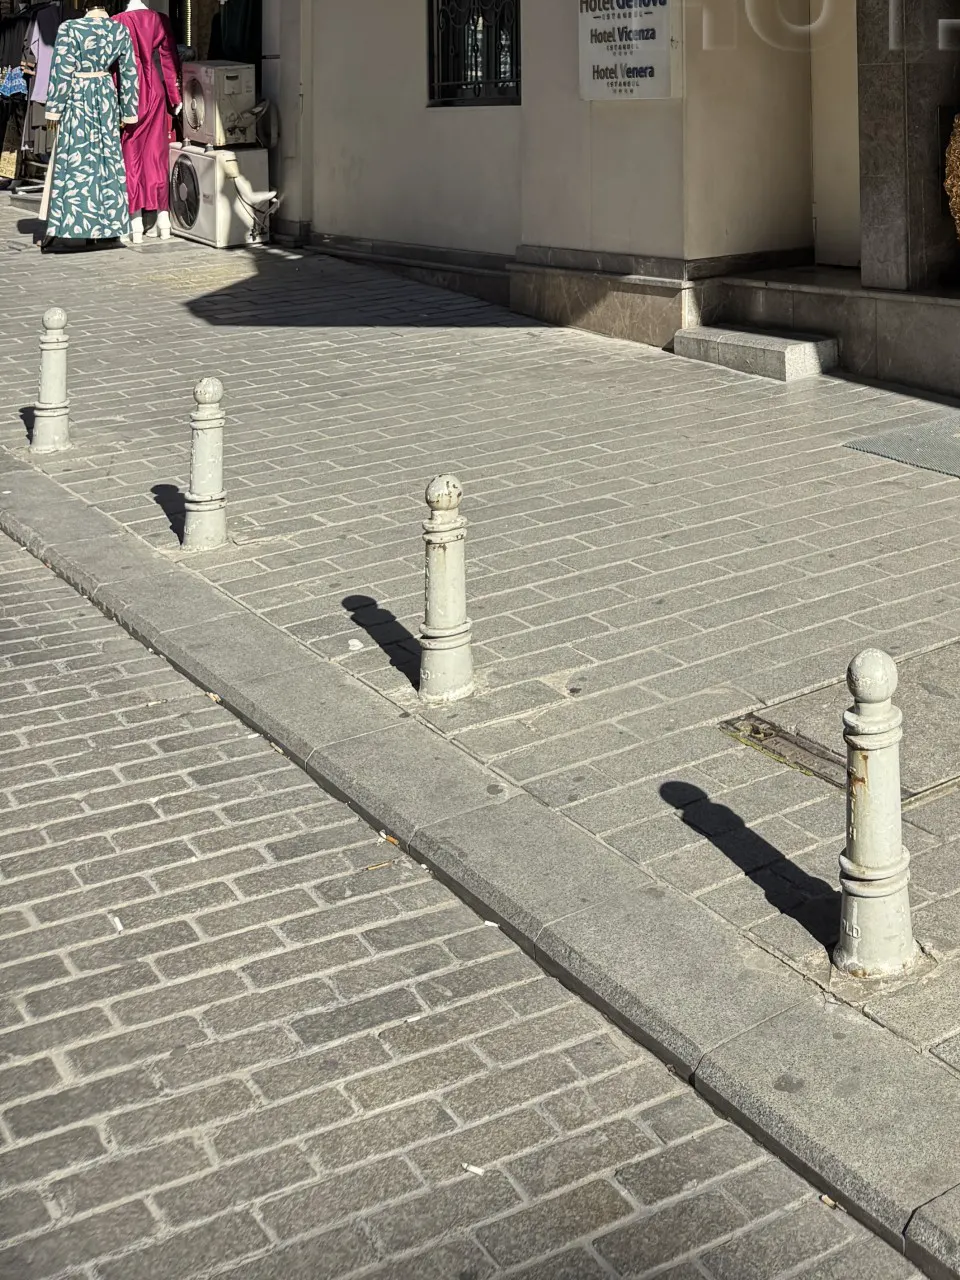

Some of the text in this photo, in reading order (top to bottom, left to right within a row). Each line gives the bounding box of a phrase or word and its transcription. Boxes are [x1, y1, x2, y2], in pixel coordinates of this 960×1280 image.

[590, 25, 657, 44] Hotel Vicenza
[592, 63, 655, 81] Hotel Venera
